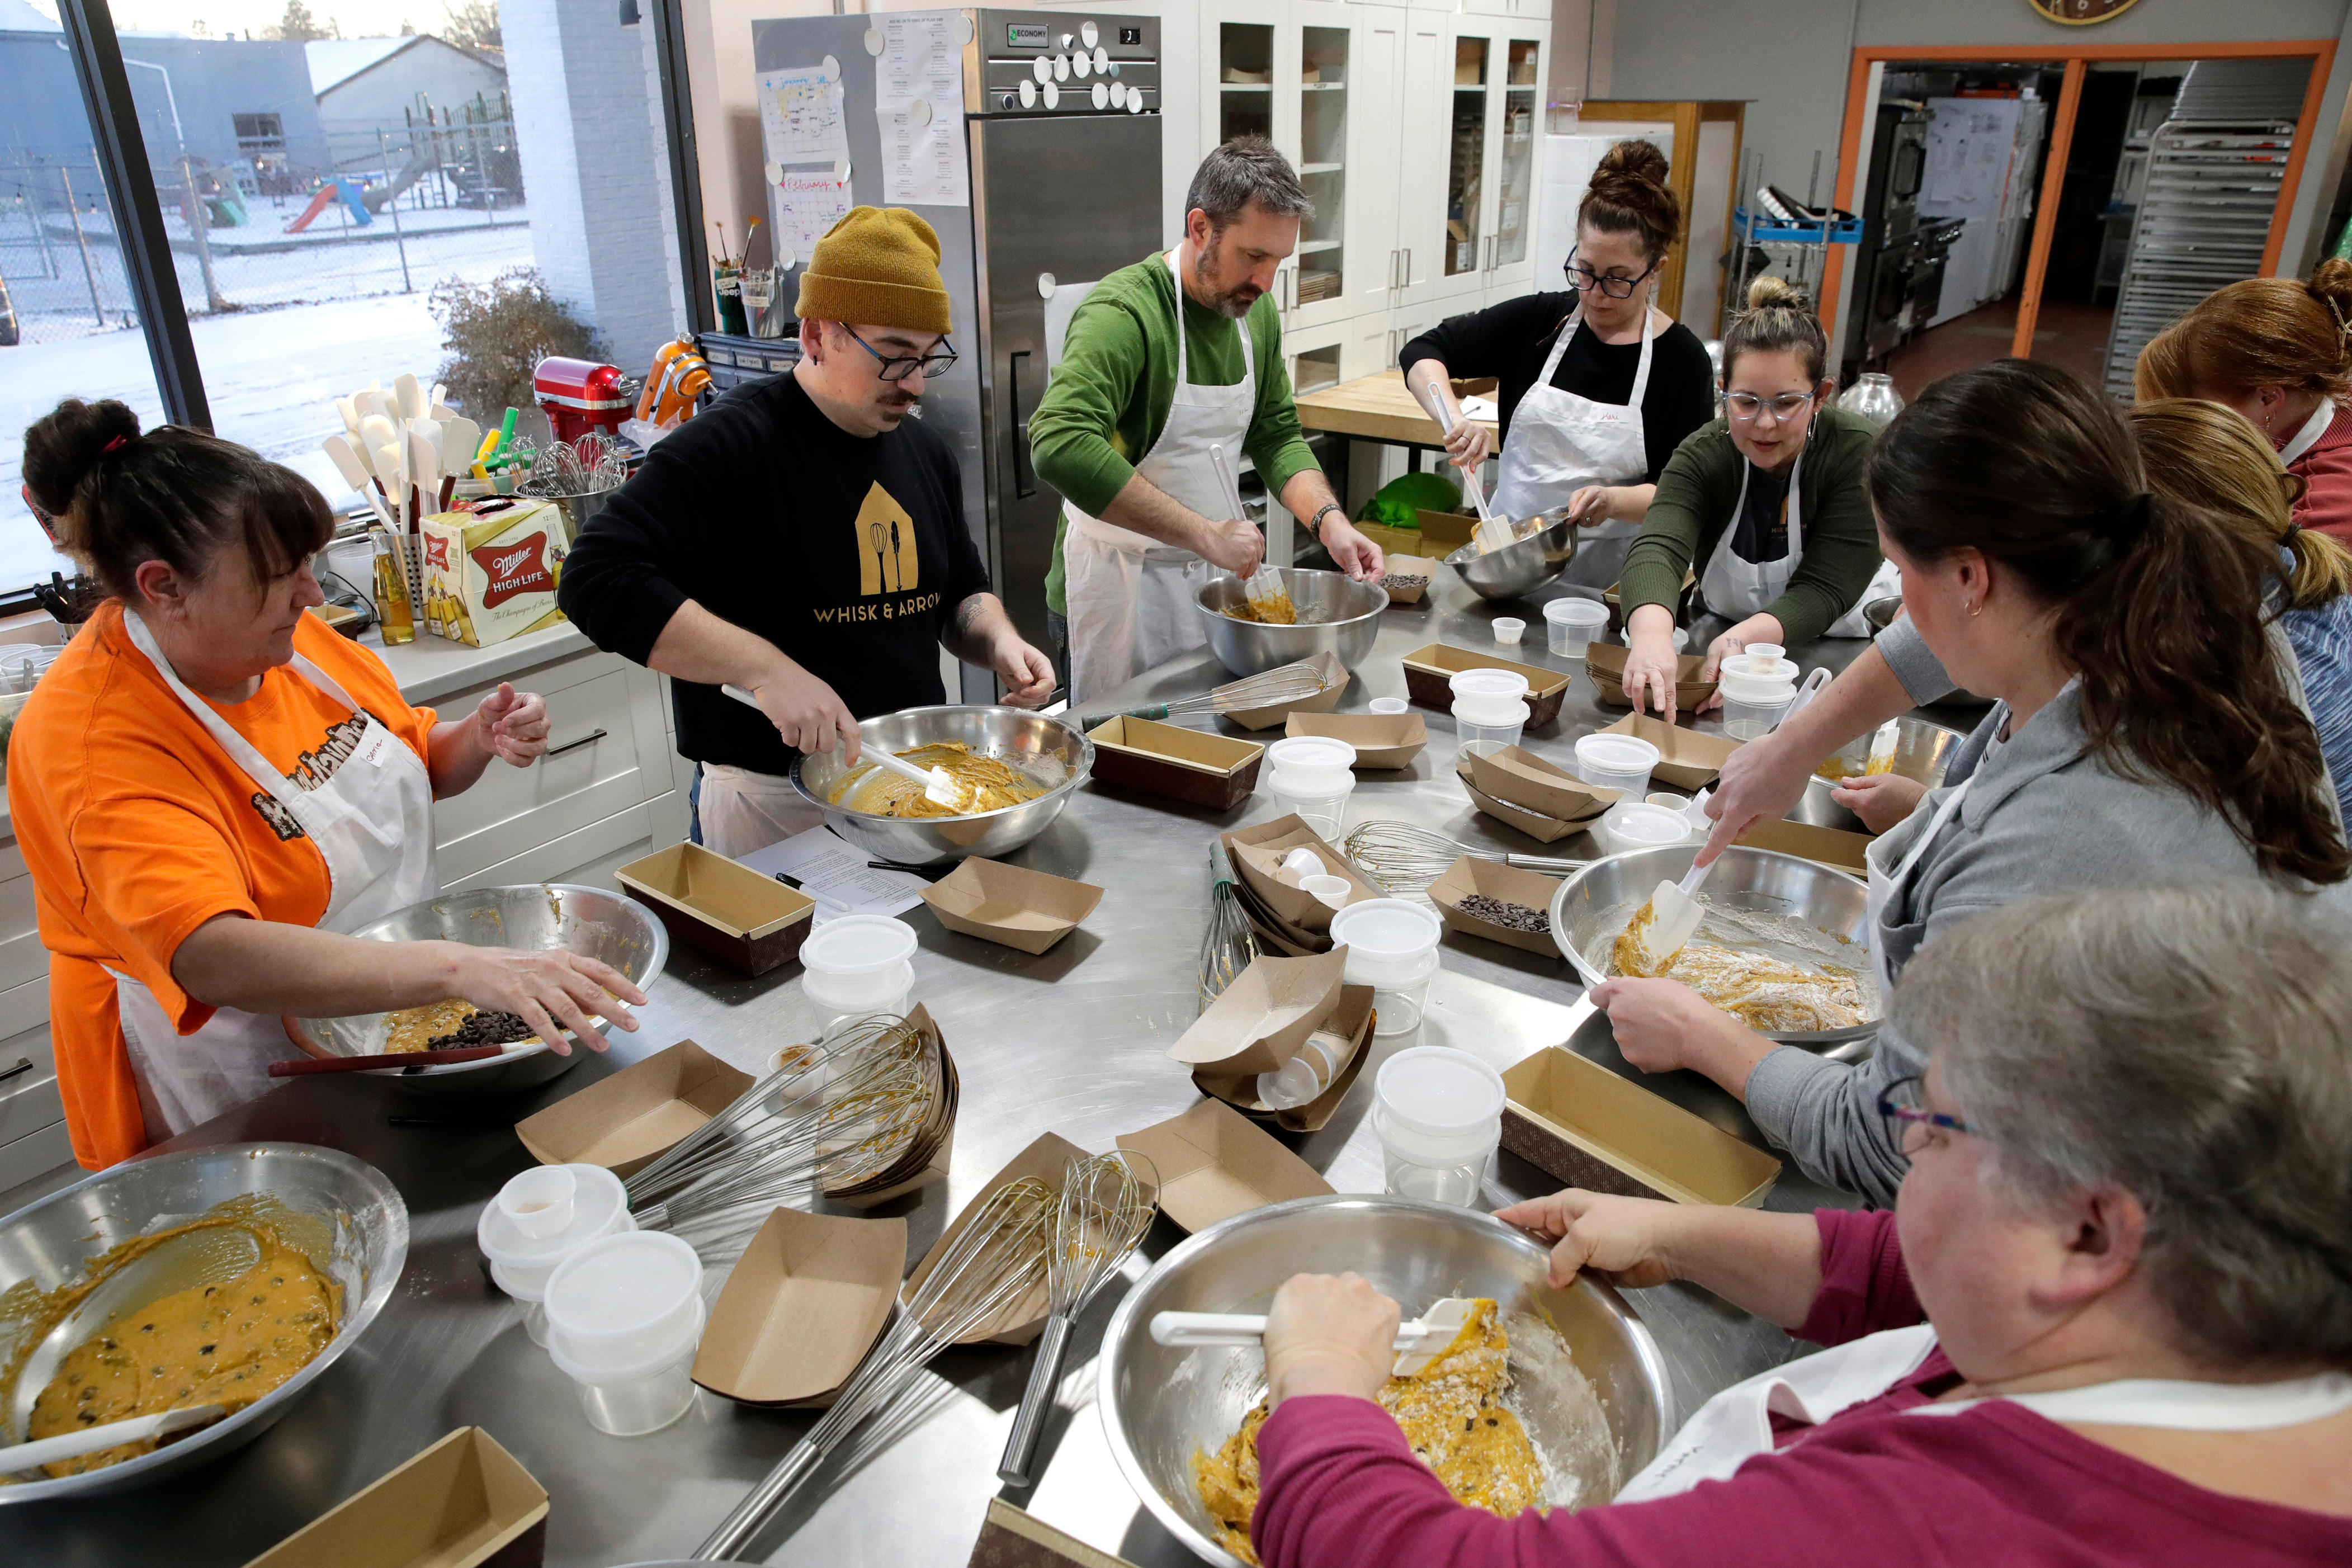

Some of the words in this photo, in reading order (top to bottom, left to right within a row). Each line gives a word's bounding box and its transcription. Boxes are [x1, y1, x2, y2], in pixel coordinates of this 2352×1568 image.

[2077, 0, 2089, 10] 6
[719, 287, 740, 297] Jeep
[429, 541, 443, 554] Miller
[493, 546, 532, 579] Miller
[493, 576, 521, 593] HIGH
[522, 571, 543, 585] LIFE
[491, 612, 503, 622] The
[503, 603, 532, 618] Champagne
[531, 599, 539, 612] of
[813, 604, 878, 623] WHISK
[883, 603, 893, 619] &
